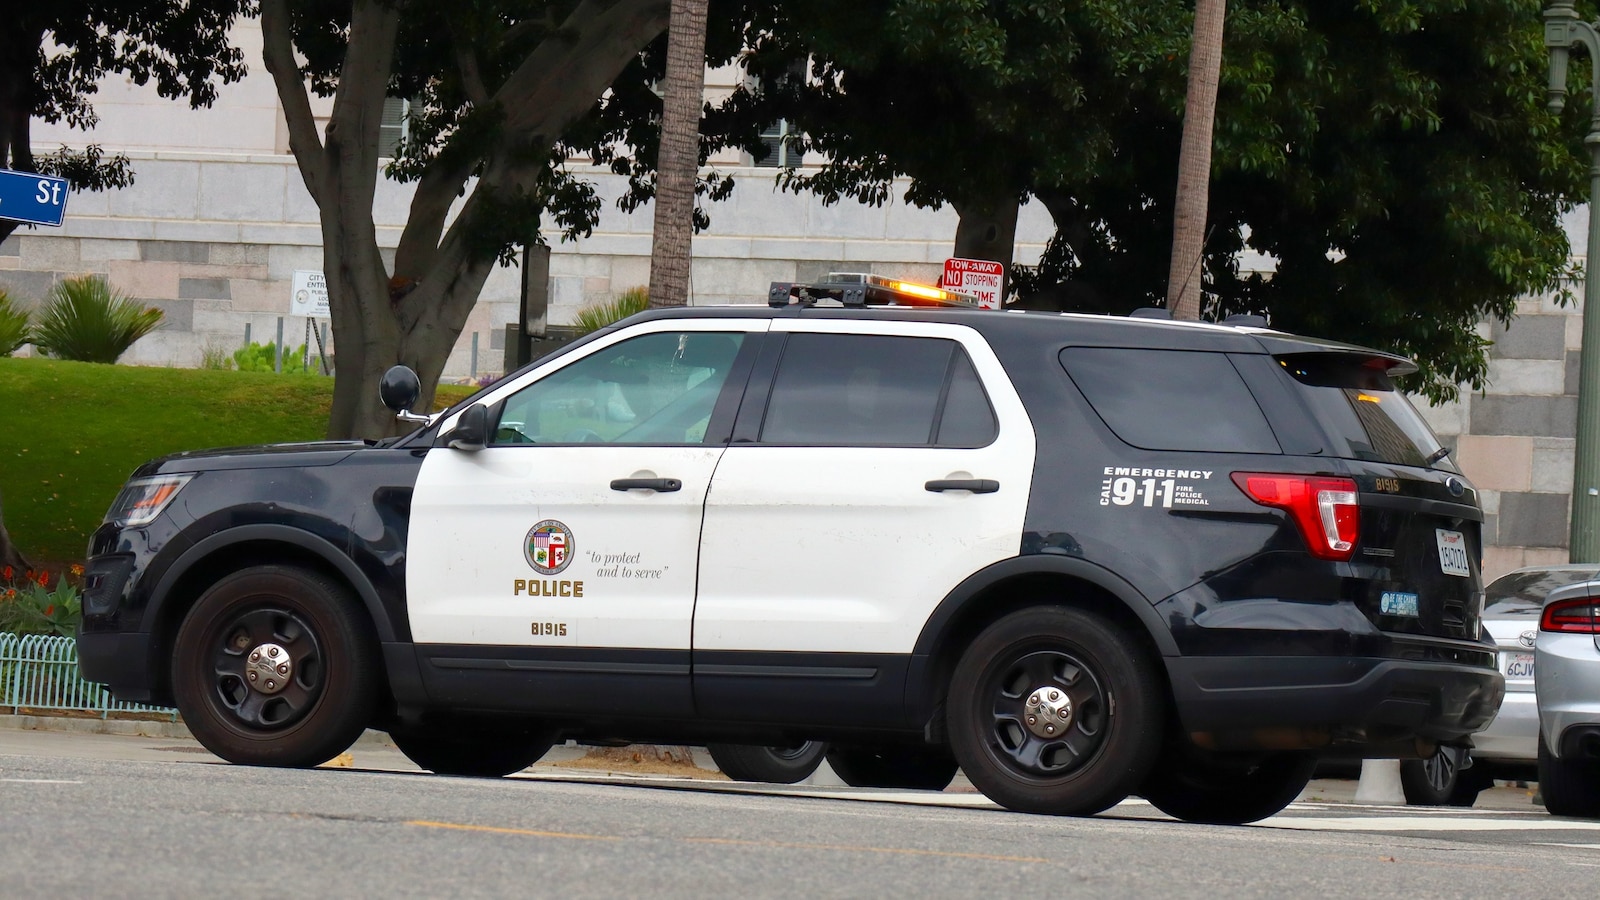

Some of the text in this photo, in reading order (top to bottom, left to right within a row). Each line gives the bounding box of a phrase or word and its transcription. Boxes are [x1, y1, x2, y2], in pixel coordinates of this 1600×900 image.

[36, 180, 61, 205] St
[950, 260, 997, 272] TOW-AWAY
[946, 270, 997, 287] NO STOPPING
[1104, 467, 1213, 479] EMERGENCY
[1376, 478, 1400, 491] 81915
[1100, 478, 1112, 506] CALL
[604, 552, 640, 566] protect
[597, 566, 619, 578] and
[622, 567, 631, 578] to
[514, 579, 583, 597] POLICE
[531, 622, 567, 636] 81915
